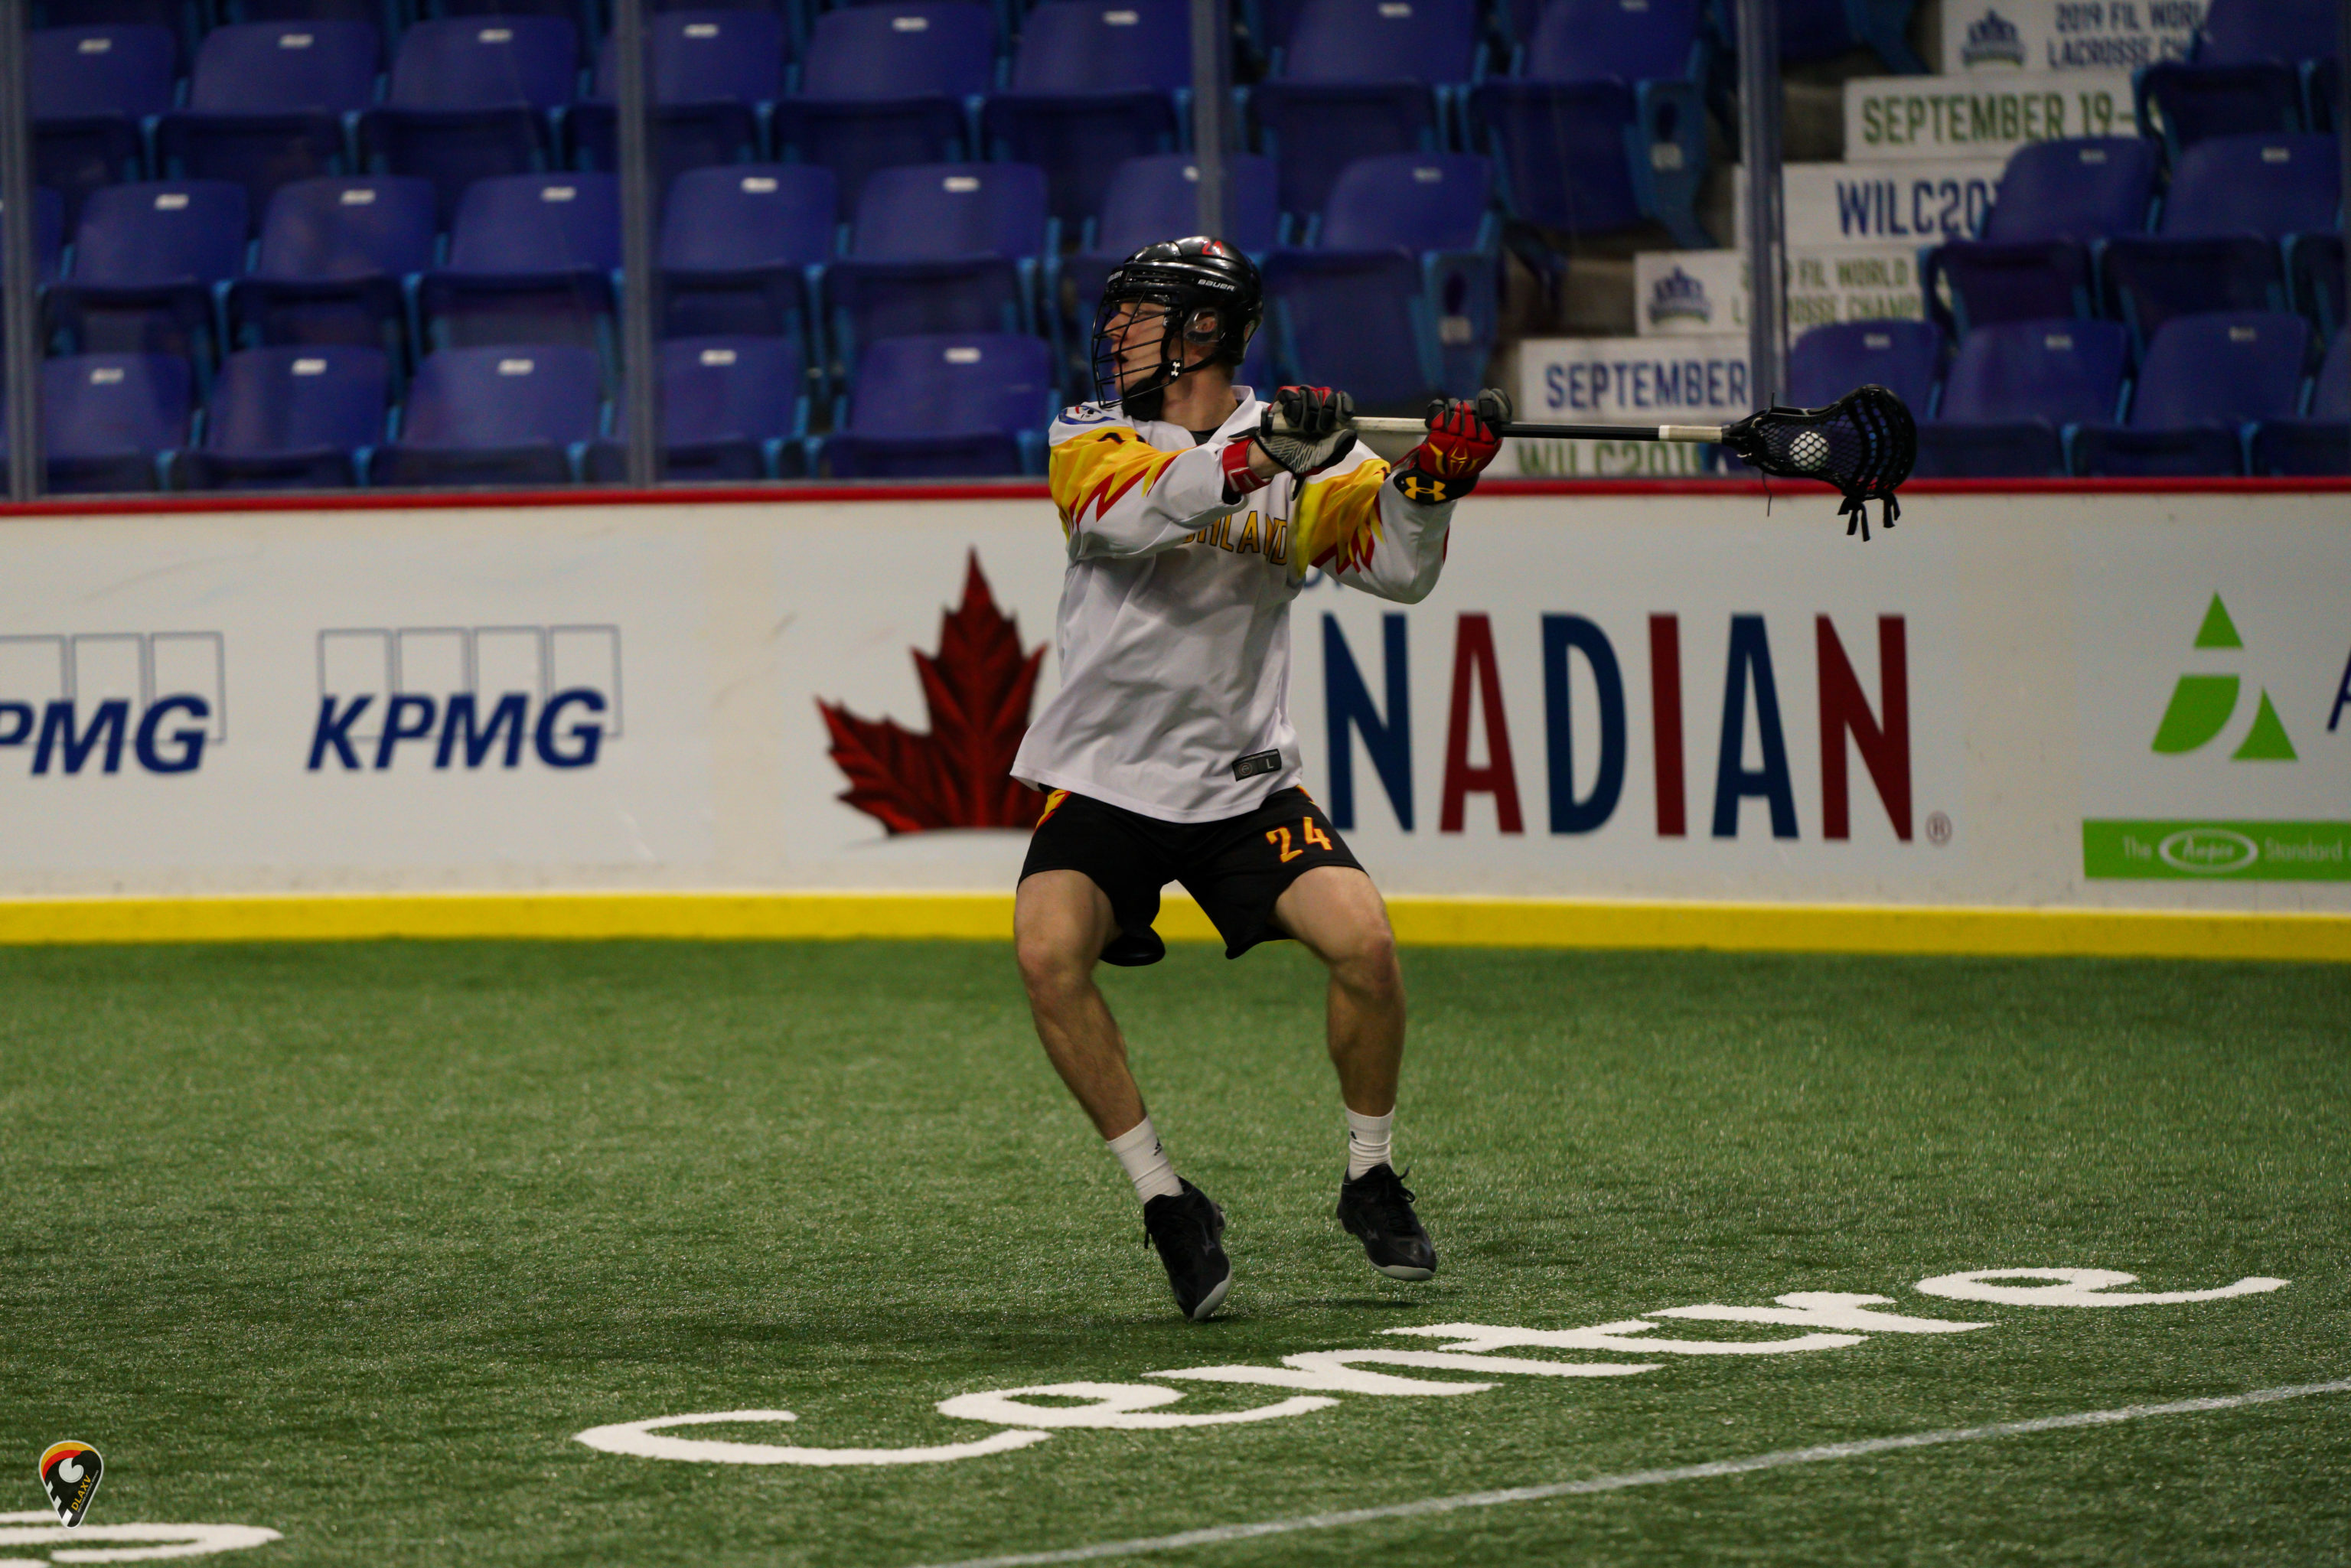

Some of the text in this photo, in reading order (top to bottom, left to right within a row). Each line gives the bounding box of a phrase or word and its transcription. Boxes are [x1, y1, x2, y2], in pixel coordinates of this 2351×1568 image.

[1863, 91, 2064, 145] SEPTEMBER
[1837, 178, 2004, 236] WILC20
[1546, 359, 1748, 410] SEPTEMBER
[305, 686, 610, 772] KPMG
[1321, 610, 1914, 843] NADIAN
[1265, 817, 1333, 863] 24
[2123, 835, 2152, 862] The
[2264, 836, 2344, 863] Standard
[573, 1266, 2292, 1468] Centre
